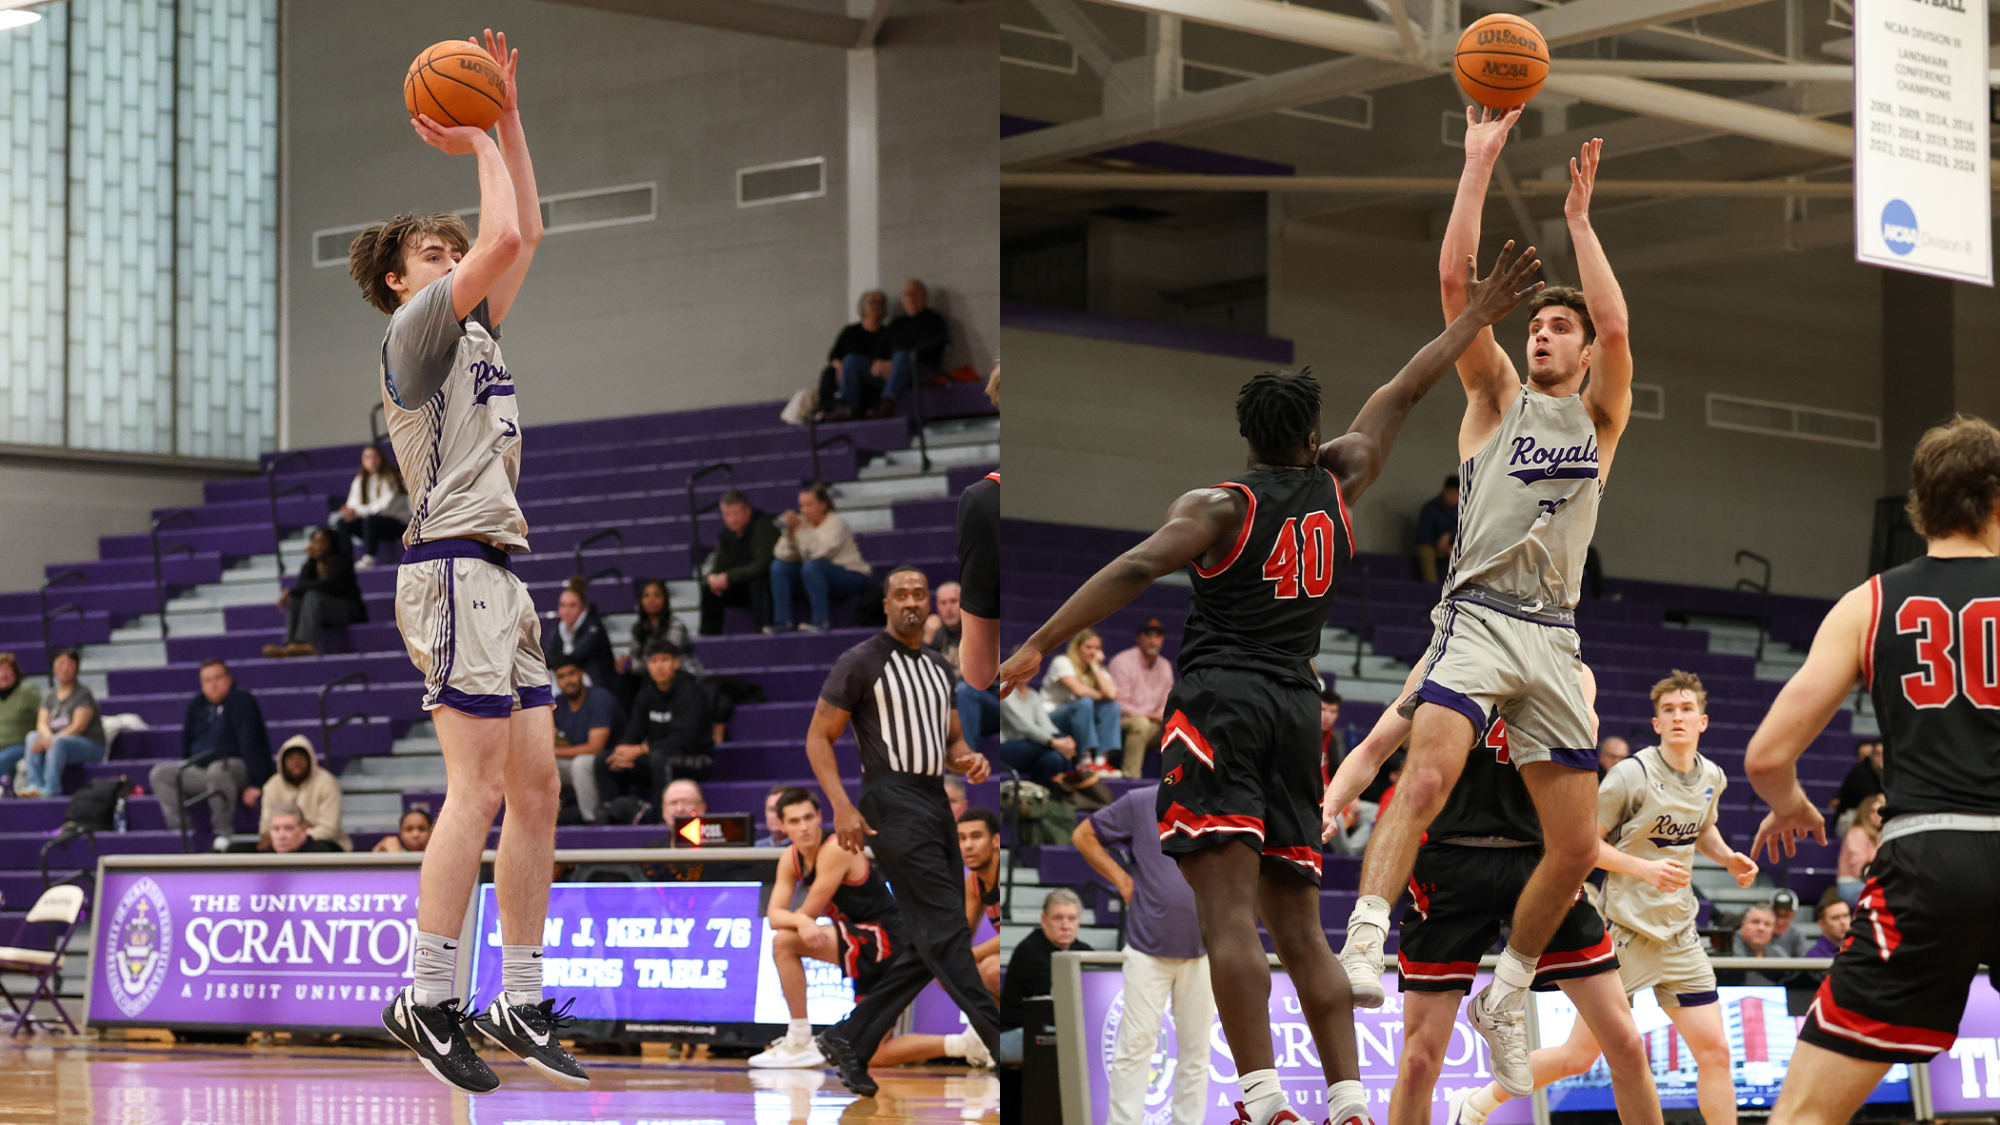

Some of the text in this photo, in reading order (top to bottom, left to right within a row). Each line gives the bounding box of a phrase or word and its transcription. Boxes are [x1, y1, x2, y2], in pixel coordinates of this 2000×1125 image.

[1477, 29, 1537, 52] Wilson
[1884, 21, 1910, 37] NCAA
[1912, 27, 1952, 47] DIVISION
[1482, 60, 1528, 77] NCAA
[1898, 47, 1949, 69] LANDMARK
[1895, 62, 1952, 87] CONFERENCE
[1896, 79, 1951, 102] CHAMPIONS
[1262, 510, 1334, 600] 40
[1895, 595, 2000, 710] 30
[1650, 813, 1704, 845] Royal
[190, 894, 242, 913] THE
[250, 894, 409, 913] UNIVERSITY
[488, 918, 752, 949] JN J. KELLY '76
[541, 957, 729, 989] RERS TABLE
[181, 982, 405, 1002] A JESUIT UNIVERS
[1217, 1091, 1231, 1107] A
